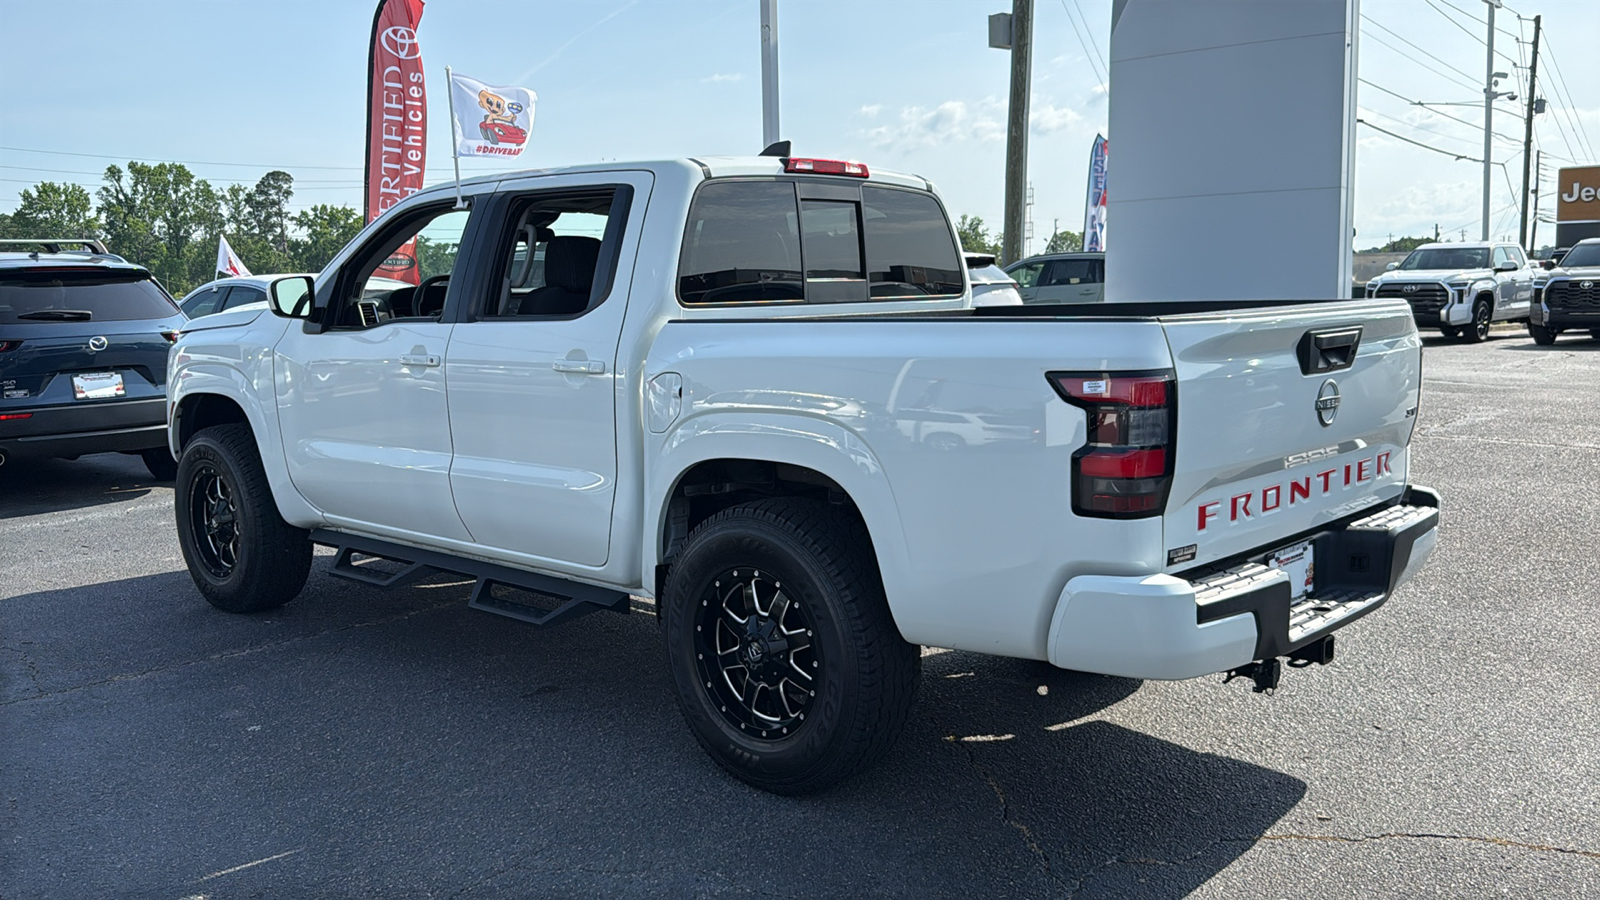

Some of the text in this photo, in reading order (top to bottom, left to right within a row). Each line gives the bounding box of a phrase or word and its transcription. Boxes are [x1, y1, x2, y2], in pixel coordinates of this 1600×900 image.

[375, 65, 406, 218] ERTIFIED
[403, 72, 423, 176] Vehicles
[1562, 182, 1600, 203] Je
[1197, 451, 1391, 532] FRONTIER
